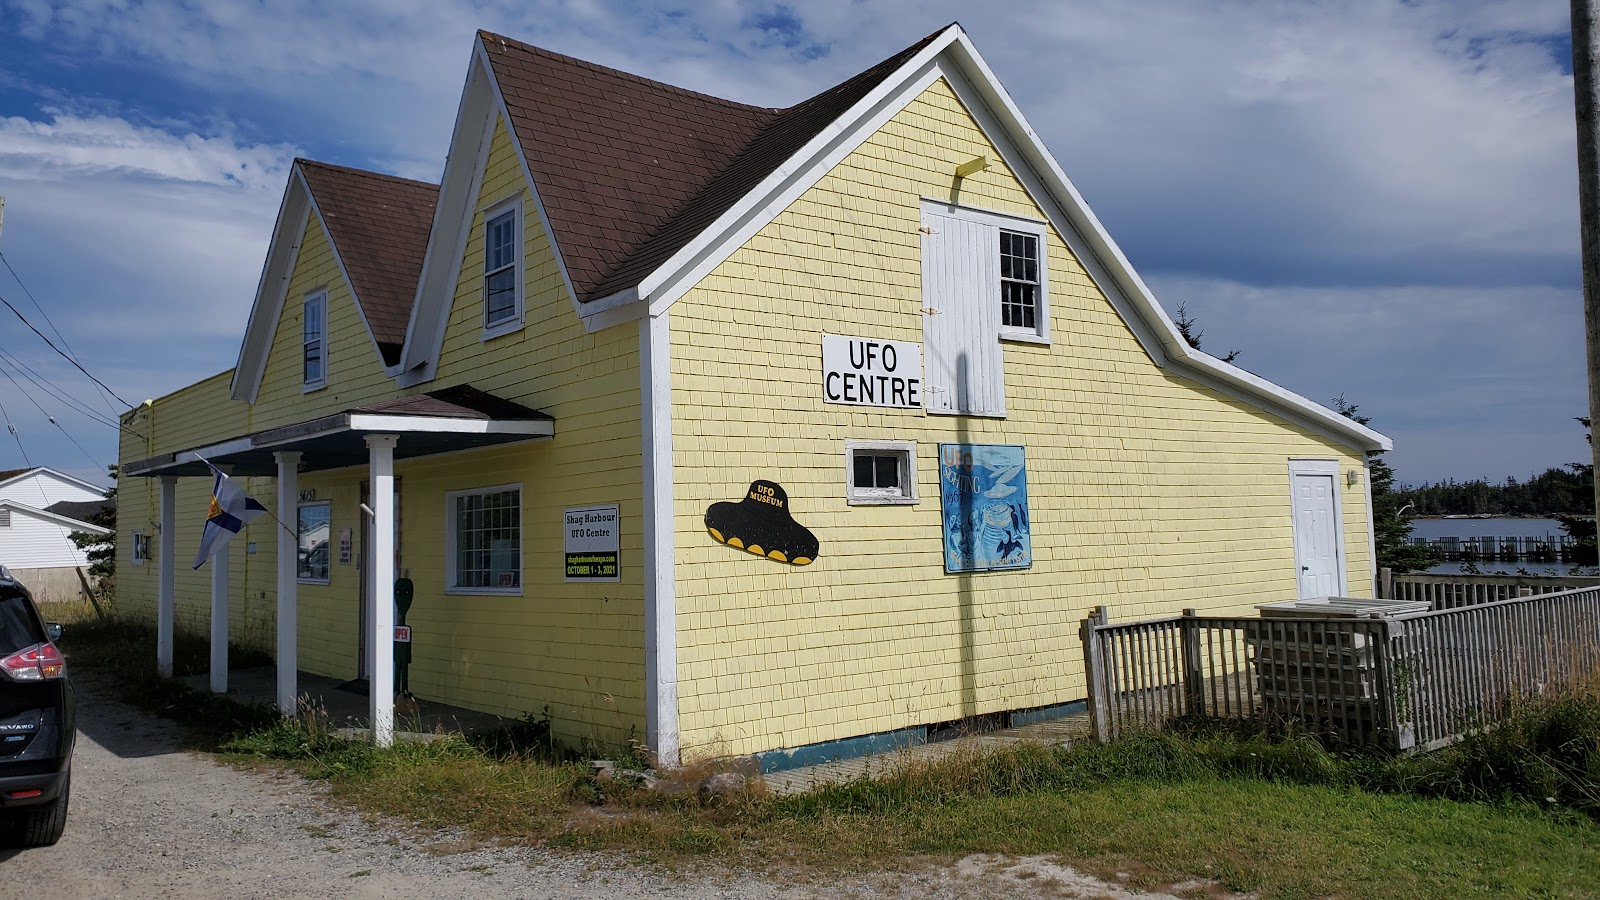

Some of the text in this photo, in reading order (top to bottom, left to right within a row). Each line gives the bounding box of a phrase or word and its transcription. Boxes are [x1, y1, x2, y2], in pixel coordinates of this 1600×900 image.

[849, 340, 897, 373] UFO
[826, 371, 921, 406] CENTRE
[943, 447, 974, 472] UFO
[943, 467, 981, 494] SIGHTING
[757, 485, 775, 496] UFO
[750, 491, 784, 508] MUSEUM
[945, 493, 963, 507] 1967
[566, 513, 615, 525] Shag Harbour
[571, 528, 610, 538] UFO Centre
[567, 565, 590, 574] OCTOBER
[603, 565, 615, 574] 2021
[394, 628, 408, 640] OPEN
